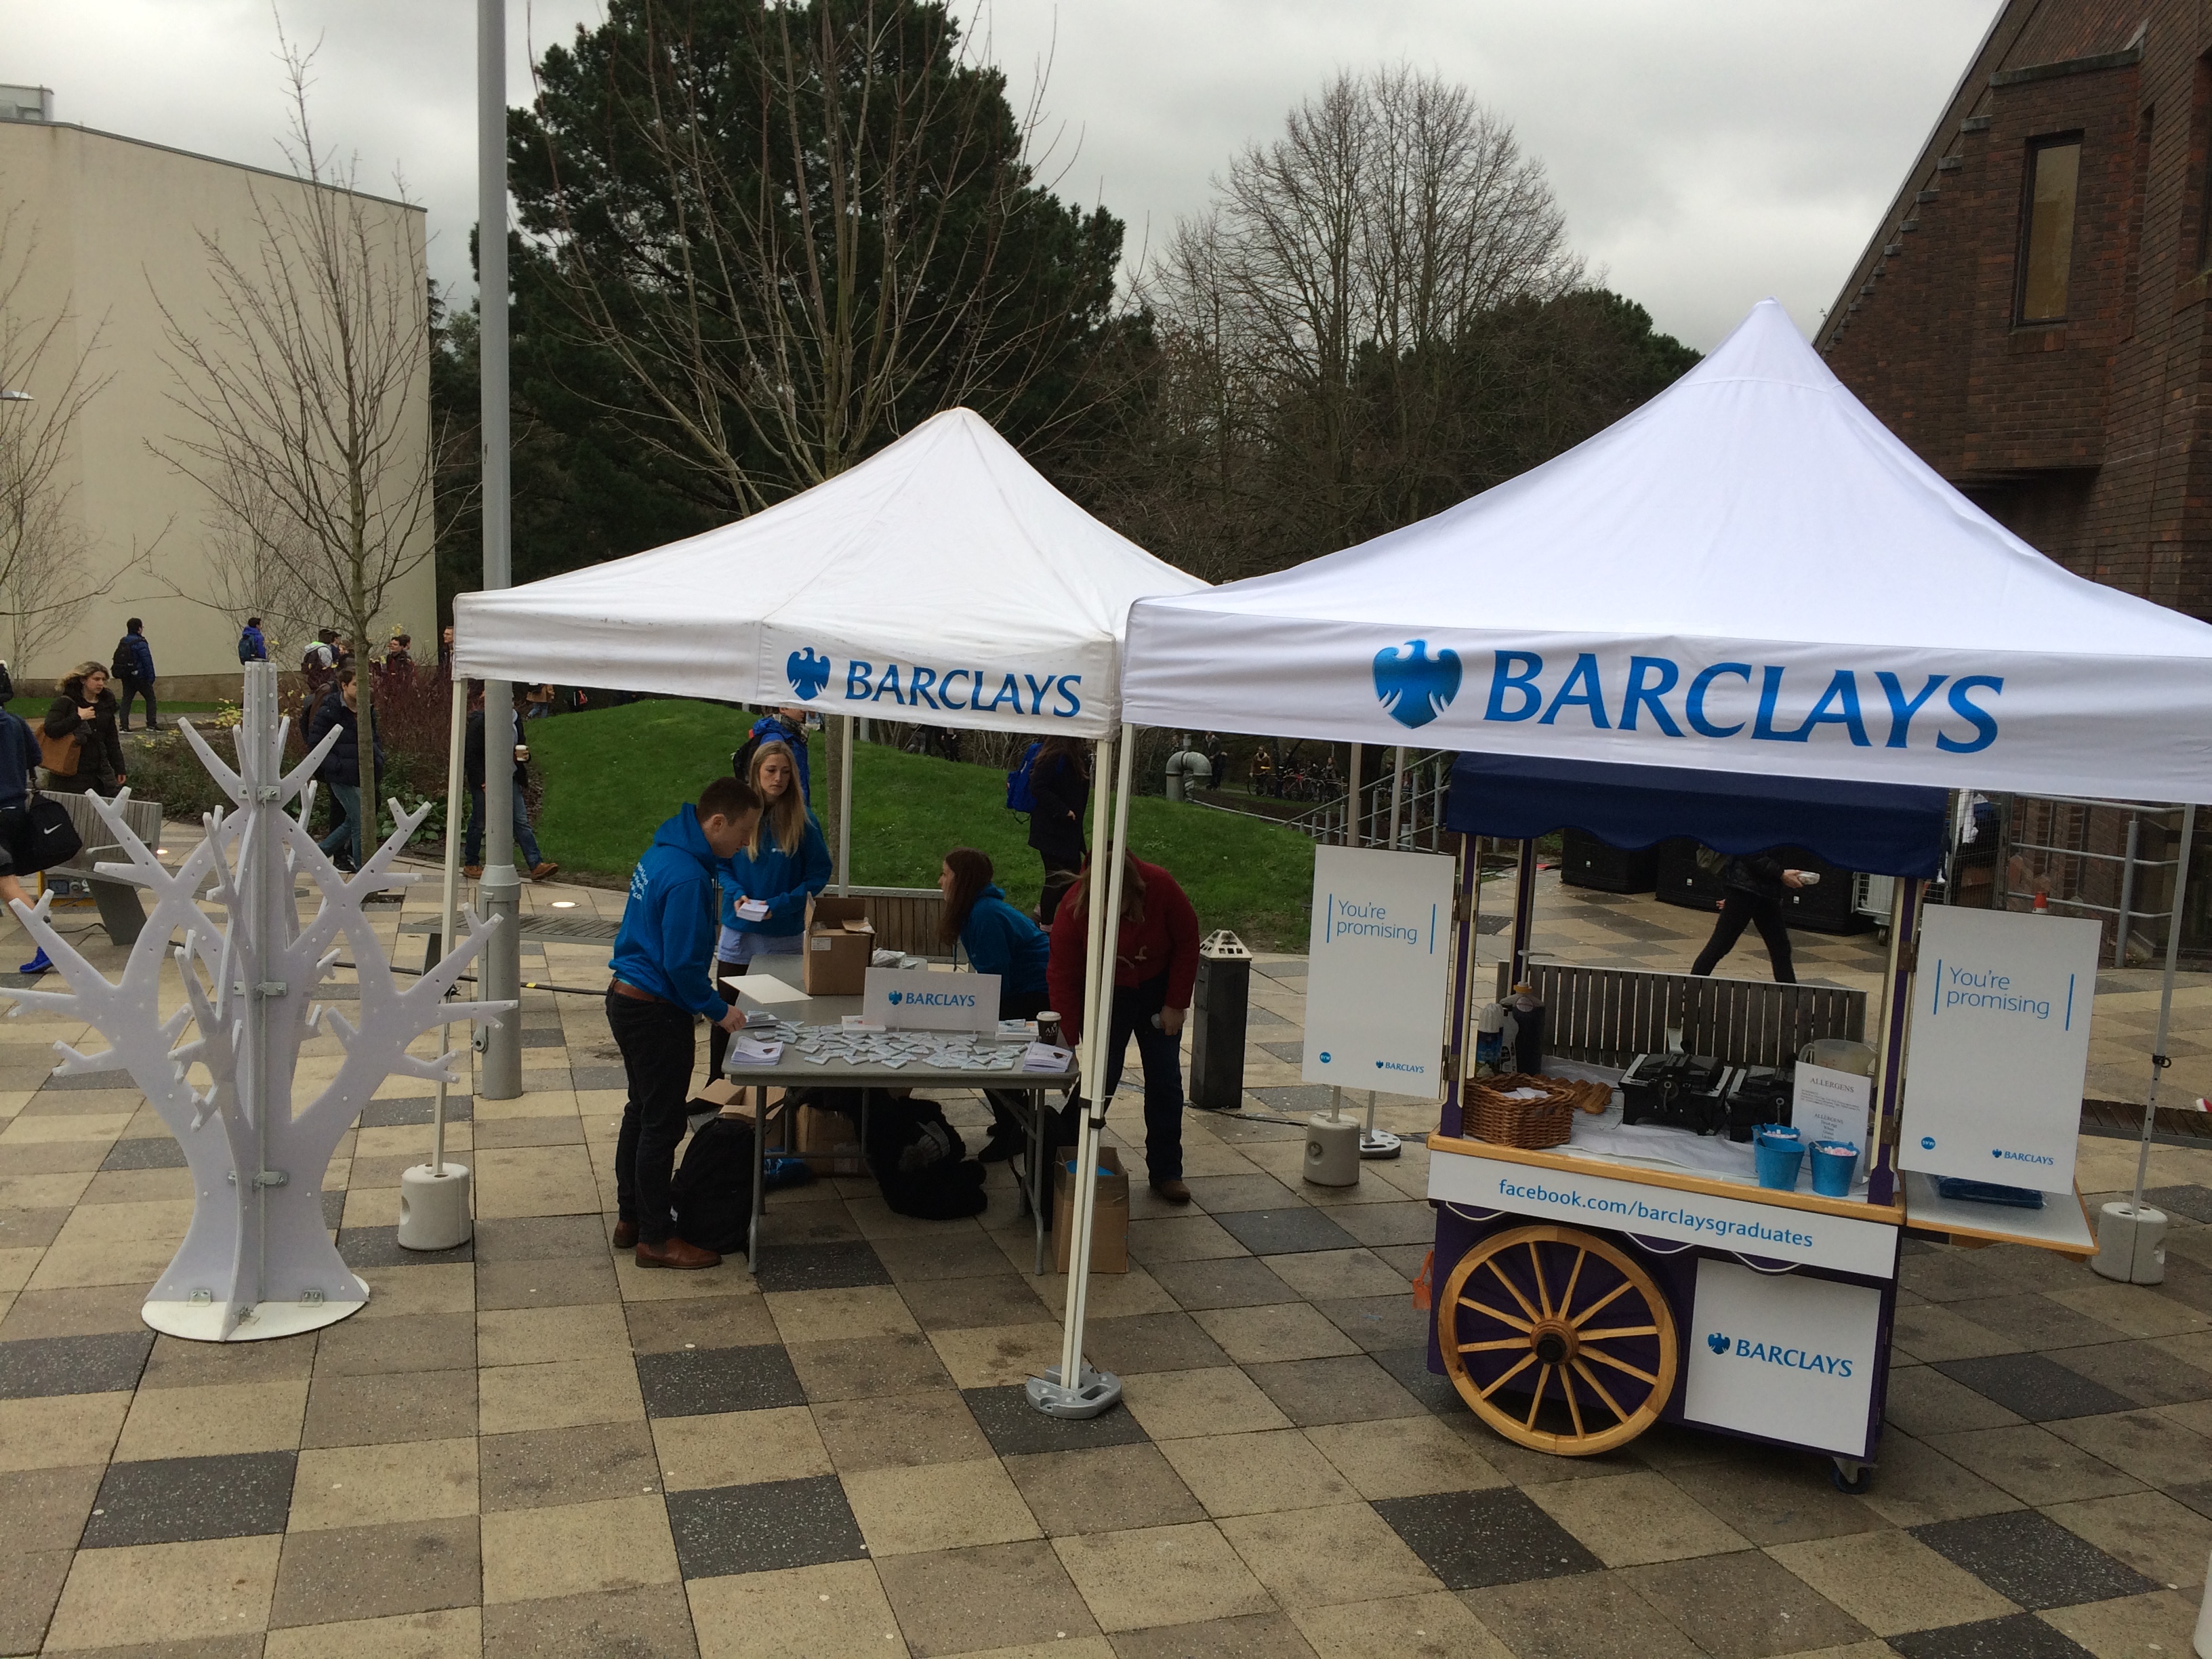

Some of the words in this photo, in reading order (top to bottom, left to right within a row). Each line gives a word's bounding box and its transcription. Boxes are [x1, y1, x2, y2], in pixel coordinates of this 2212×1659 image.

[845, 660, 1082, 718] BARCLAYS
[1484, 650, 2004, 754] BARCLAYS
[1338, 899, 1387, 920] You're
[1336, 920, 1418, 945] promising
[1950, 966, 2010, 990] You're
[905, 993, 975, 1006] BARCLAYS
[1947, 989, 2050, 1019] promising
[1385, 1062, 1424, 1073] BARCLAYS
[1810, 1078, 1854, 1092] ALLERGENS
[2004, 1151, 2053, 1165] BARCLAYS
[1498, 1179, 1814, 1248] facebook.com/barclaysgraduates
[1735, 1338, 1853, 1378] BARCLAYS
